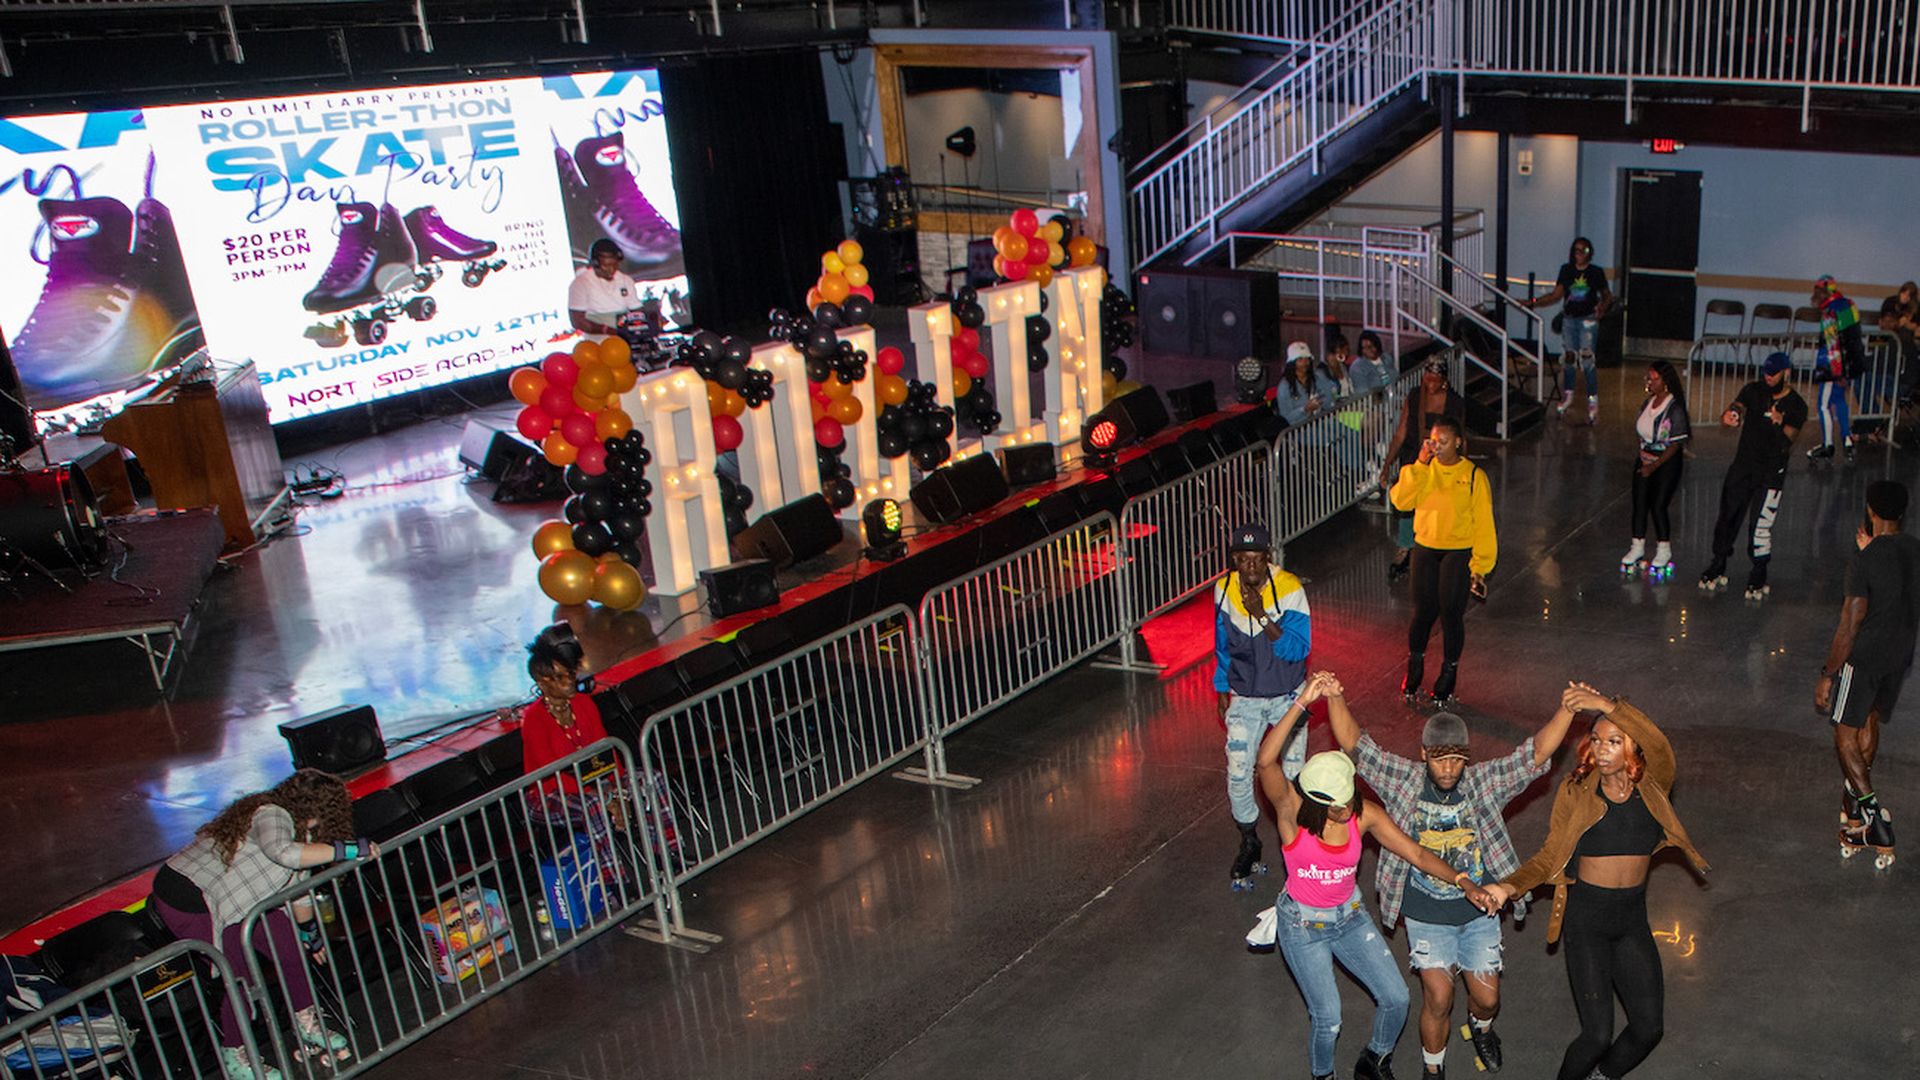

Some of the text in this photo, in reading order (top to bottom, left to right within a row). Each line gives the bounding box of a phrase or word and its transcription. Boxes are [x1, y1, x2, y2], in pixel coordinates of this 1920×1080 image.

[198, 97, 513, 145] ROLLER-THON
[200, 84, 509, 120] NO LIMIT LARRY PRESENTS
[206, 119, 520, 193] SKATE
[380, 146, 504, 214] Party
[222, 227, 307, 252] $20 PER
[226, 241, 311, 266] PERSON
[231, 261, 306, 282] 3PM-7PM
[258, 309, 559, 386] SATURDAY NOV 12TH
